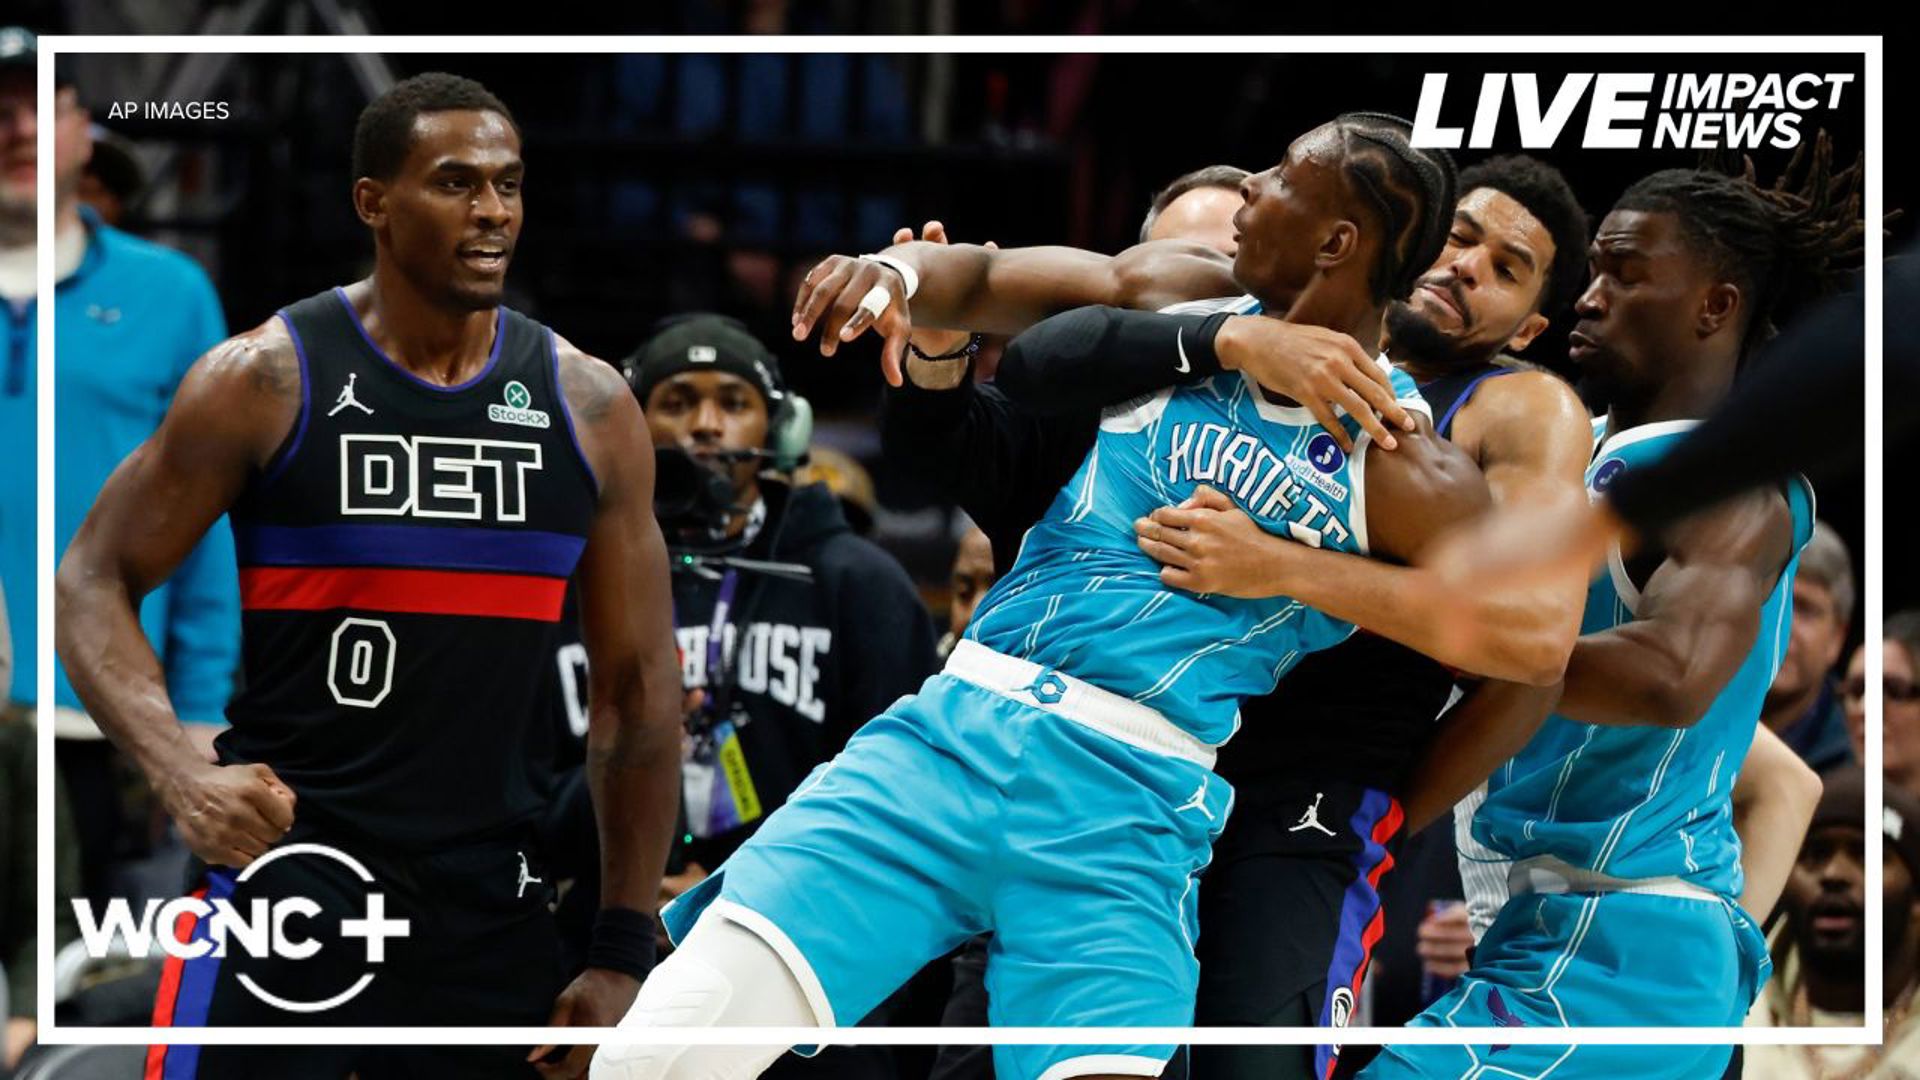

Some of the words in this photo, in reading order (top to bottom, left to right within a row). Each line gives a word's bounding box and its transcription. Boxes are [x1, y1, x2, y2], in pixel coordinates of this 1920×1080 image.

[490, 406, 548, 427] StockX
[339, 433, 543, 522] DET
[327, 617, 397, 709] 0
